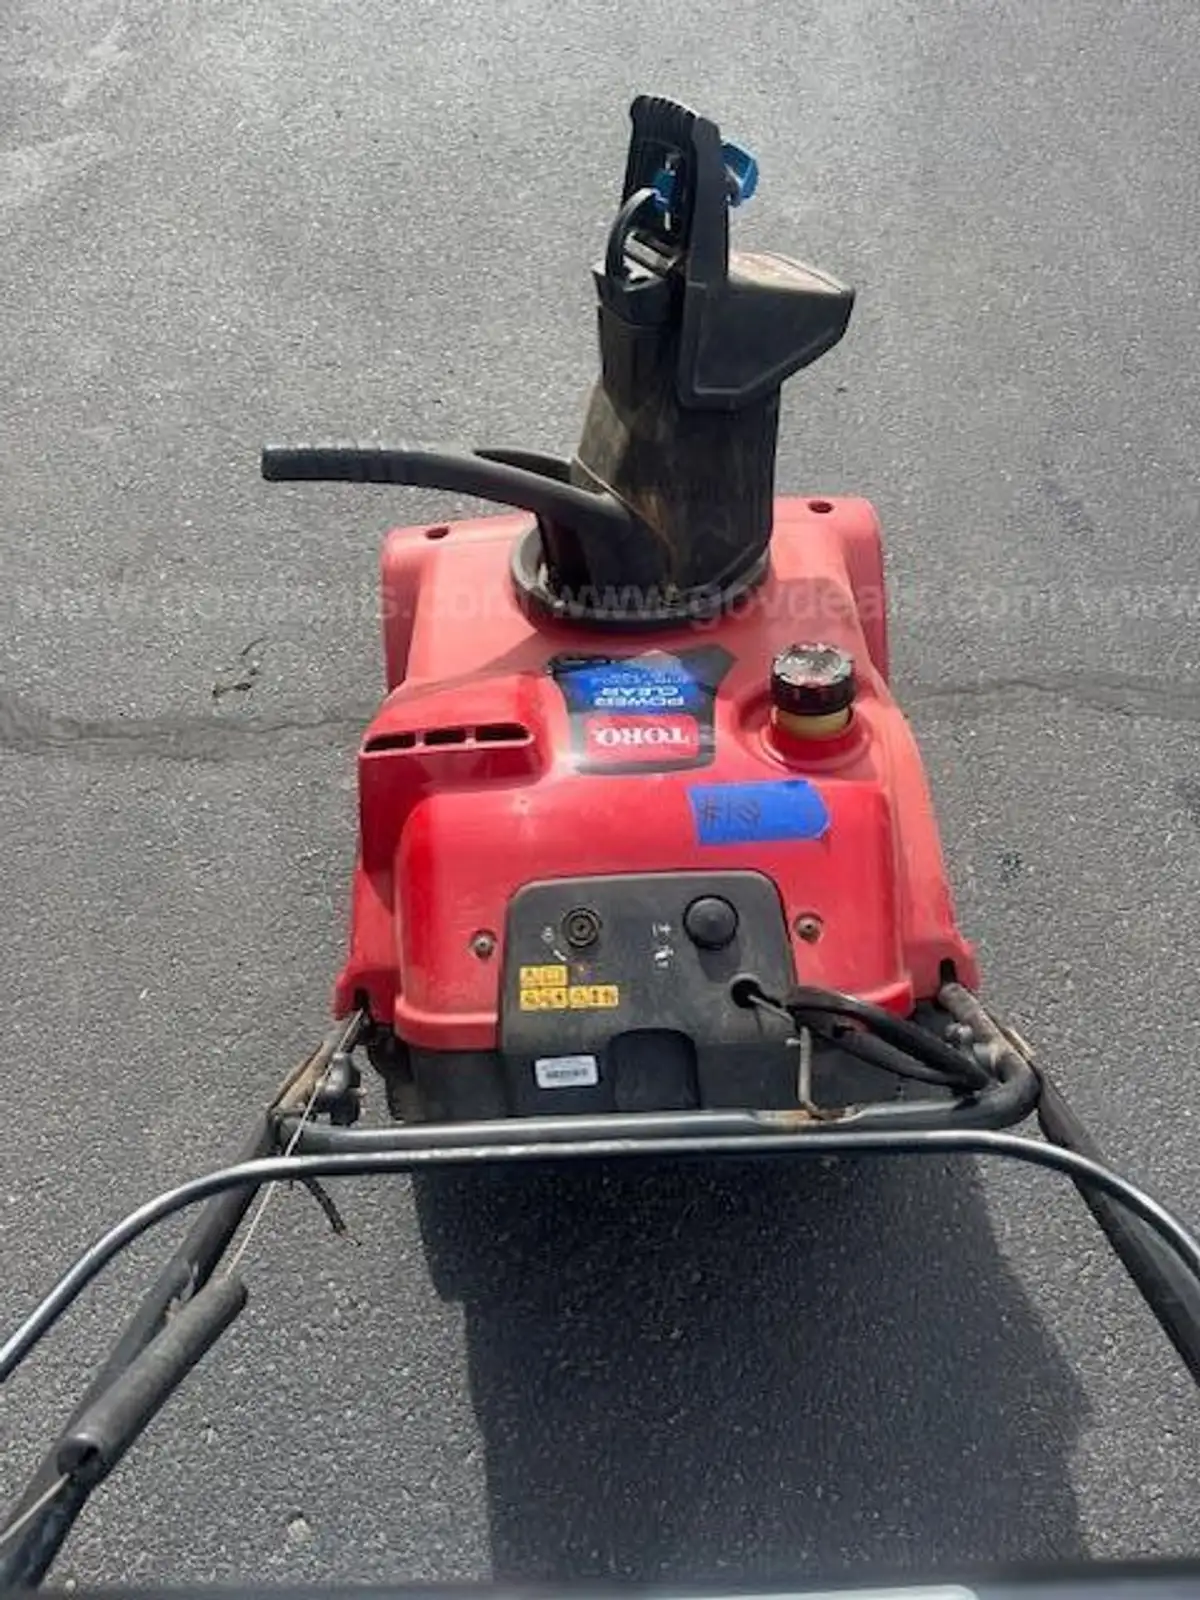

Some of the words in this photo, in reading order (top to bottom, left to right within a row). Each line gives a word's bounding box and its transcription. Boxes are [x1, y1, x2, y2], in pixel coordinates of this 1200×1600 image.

[601, 685, 679, 697] CLEAR
[594, 696, 684, 706] POWER
[595, 727, 689, 746] TORO
